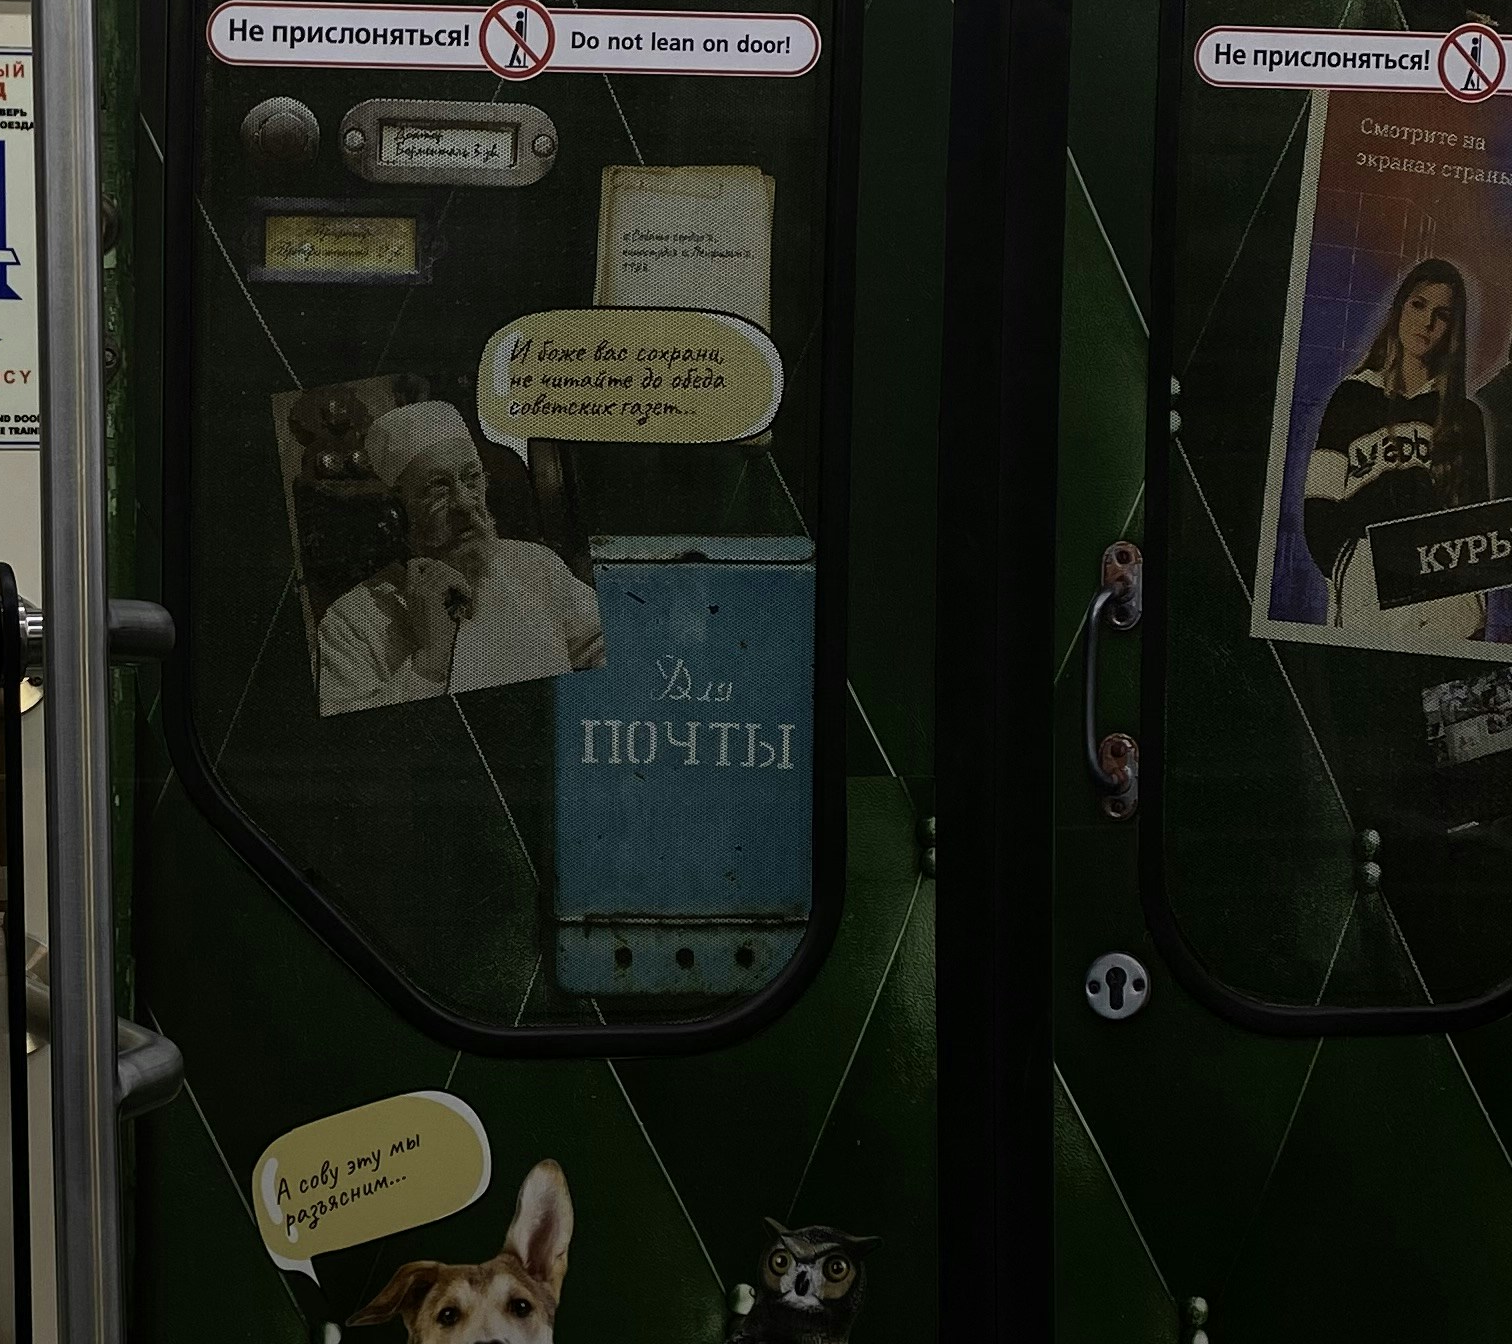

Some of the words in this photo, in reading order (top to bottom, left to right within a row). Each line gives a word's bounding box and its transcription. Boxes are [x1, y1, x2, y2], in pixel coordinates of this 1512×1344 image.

[228, 18, 265, 44] Не
[272, 21, 470, 50] прислоняться!
[570, 30, 599, 50] Do
[608, 32, 643, 51] not
[651, 31, 695, 52] lean
[702, 37, 729, 53] on
[737, 33, 792, 54] door!
[1215, 43, 1246, 66] Не
[1254, 49, 1431, 72] прислоняться!
[1360, 118, 1458, 146] Смотрите
[1462, 135, 1486, 151] на
[1356, 152, 1437, 176] экранах
[511, 340, 531, 363] И
[537, 340, 584, 364] боже
[593, 341, 628, 364] вас
[636, 343, 726, 370] сохрани,
[510, 372, 535, 389] не
[540, 370, 633, 389] читайте
[641, 371, 664, 392] до
[671, 370, 727, 392] обеда
[510, 398, 616, 418] советских
[580, 719, 796, 770] ПОЧТЫ
[277, 1177, 292, 1205] А
[300, 1160, 338, 1193] сову
[347, 1149, 380, 1175] эту
[389, 1134, 420, 1157] мы
[286, 1175, 407, 1236] разъясним...
